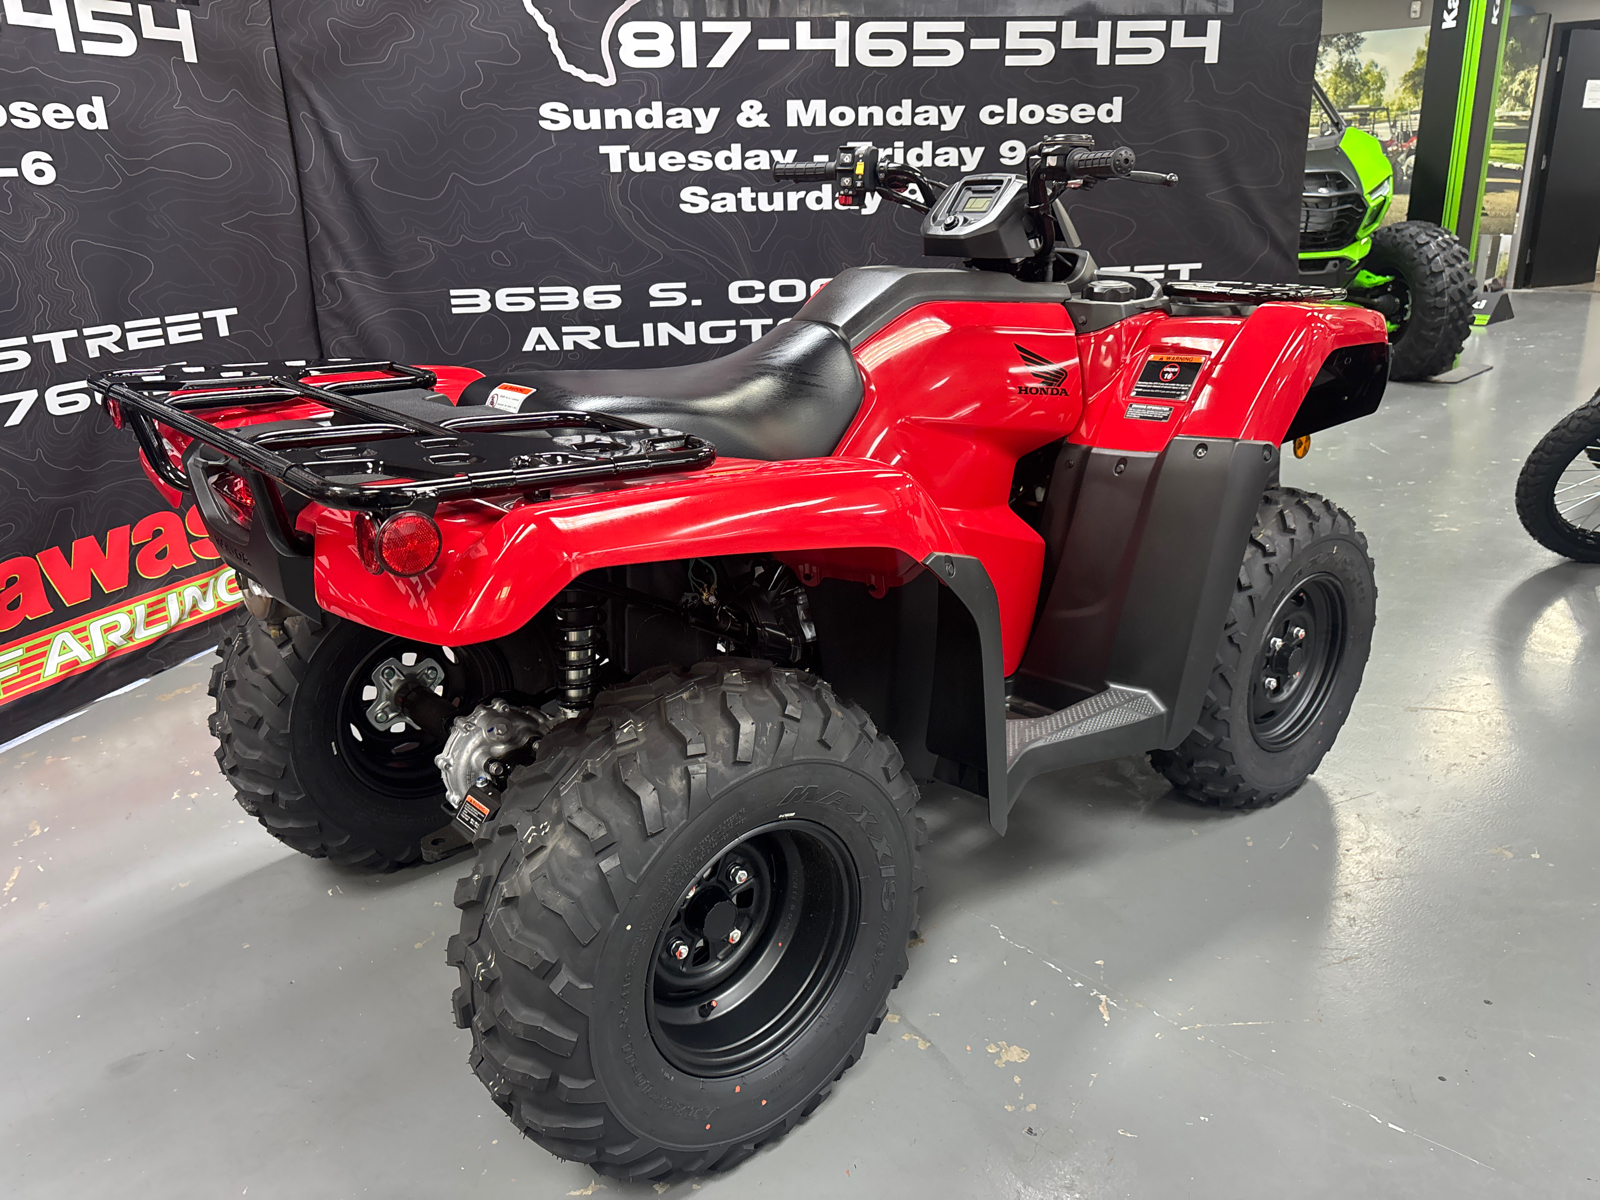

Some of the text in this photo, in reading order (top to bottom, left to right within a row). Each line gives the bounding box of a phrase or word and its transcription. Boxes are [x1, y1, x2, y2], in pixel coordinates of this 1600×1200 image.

[618, 20, 1221, 69] 817-465-5454
[538, 96, 1123, 135] Sunday & Monday closed
[449, 284, 622, 314] 3636
[648, 281, 703, 308] S.
[1017, 386, 1070, 397] HONDA
